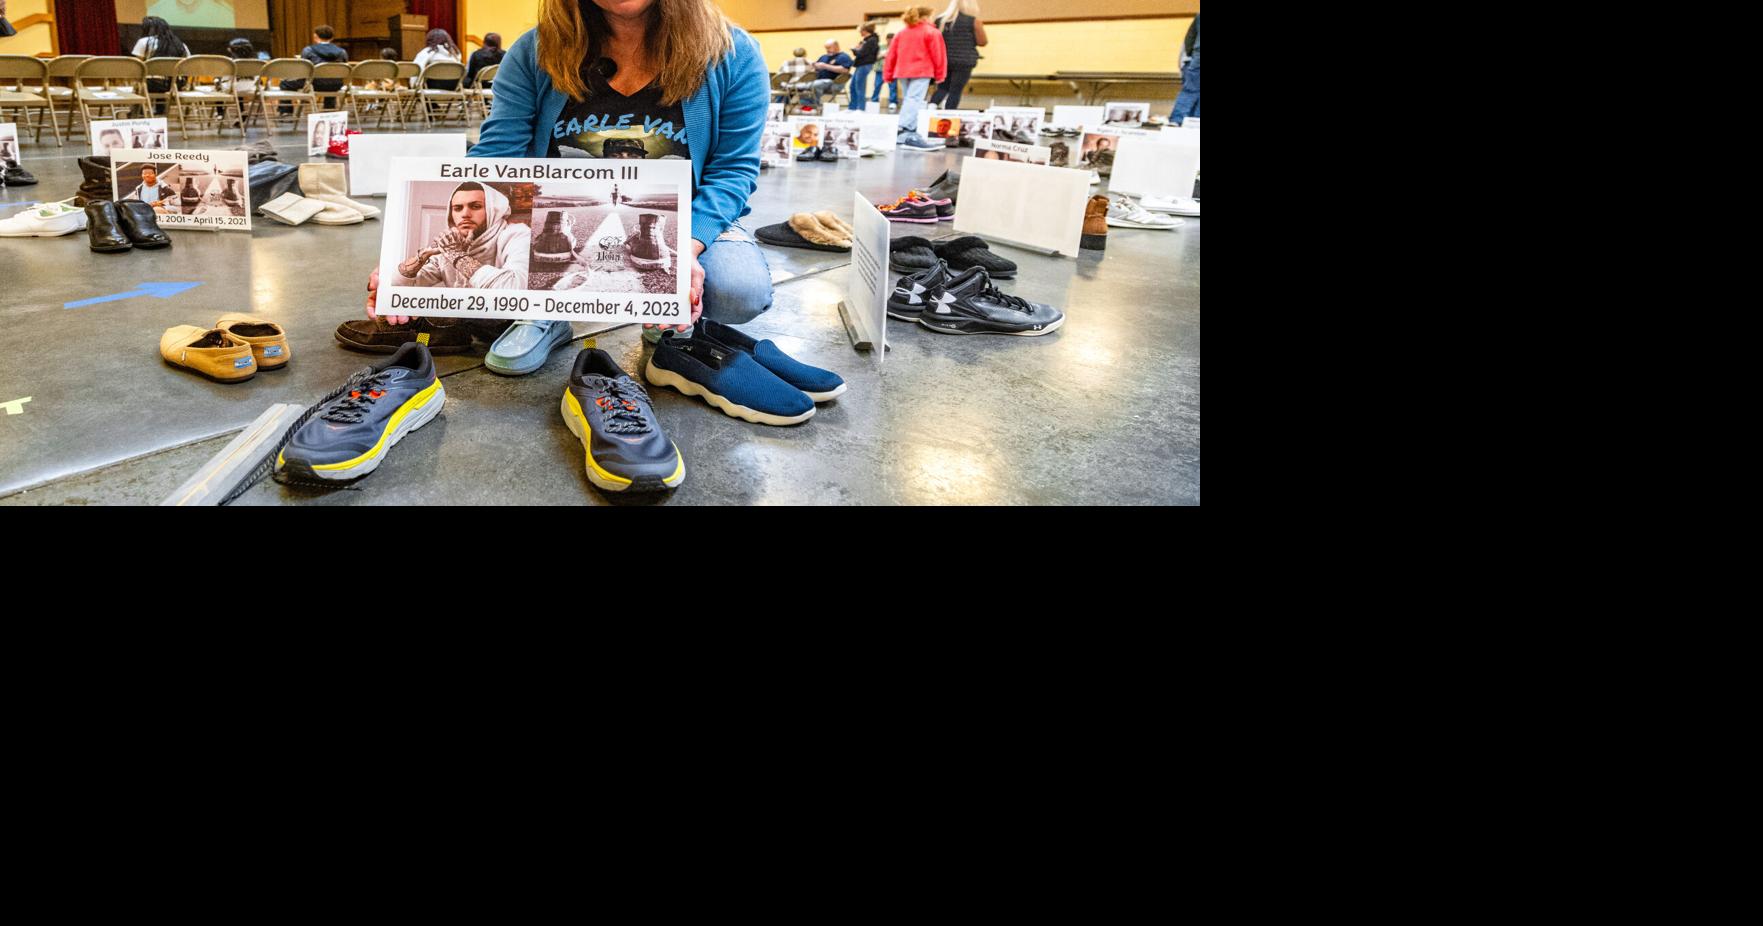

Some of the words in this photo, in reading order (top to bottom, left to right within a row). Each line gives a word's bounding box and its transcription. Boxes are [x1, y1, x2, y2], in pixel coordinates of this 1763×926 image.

[553, 113, 634, 139] EARLE
[1012, 144, 1029, 153] Cruz
[147, 152, 172, 160] Jose
[175, 152, 210, 163] Reedy
[440, 163, 489, 178] Earle
[495, 164, 614, 180] VanBlarcom
[621, 166, 638, 180] III
[164, 215, 185, 223] 2001
[193, 216, 213, 226] April
[228, 217, 247, 226] 2021
[391, 293, 463, 311] December
[467, 296, 489, 313] 29,
[494, 297, 529, 312] 1990
[545, 298, 620, 316] December
[624, 299, 638, 317] 4,
[642, 301, 680, 317] 2023
